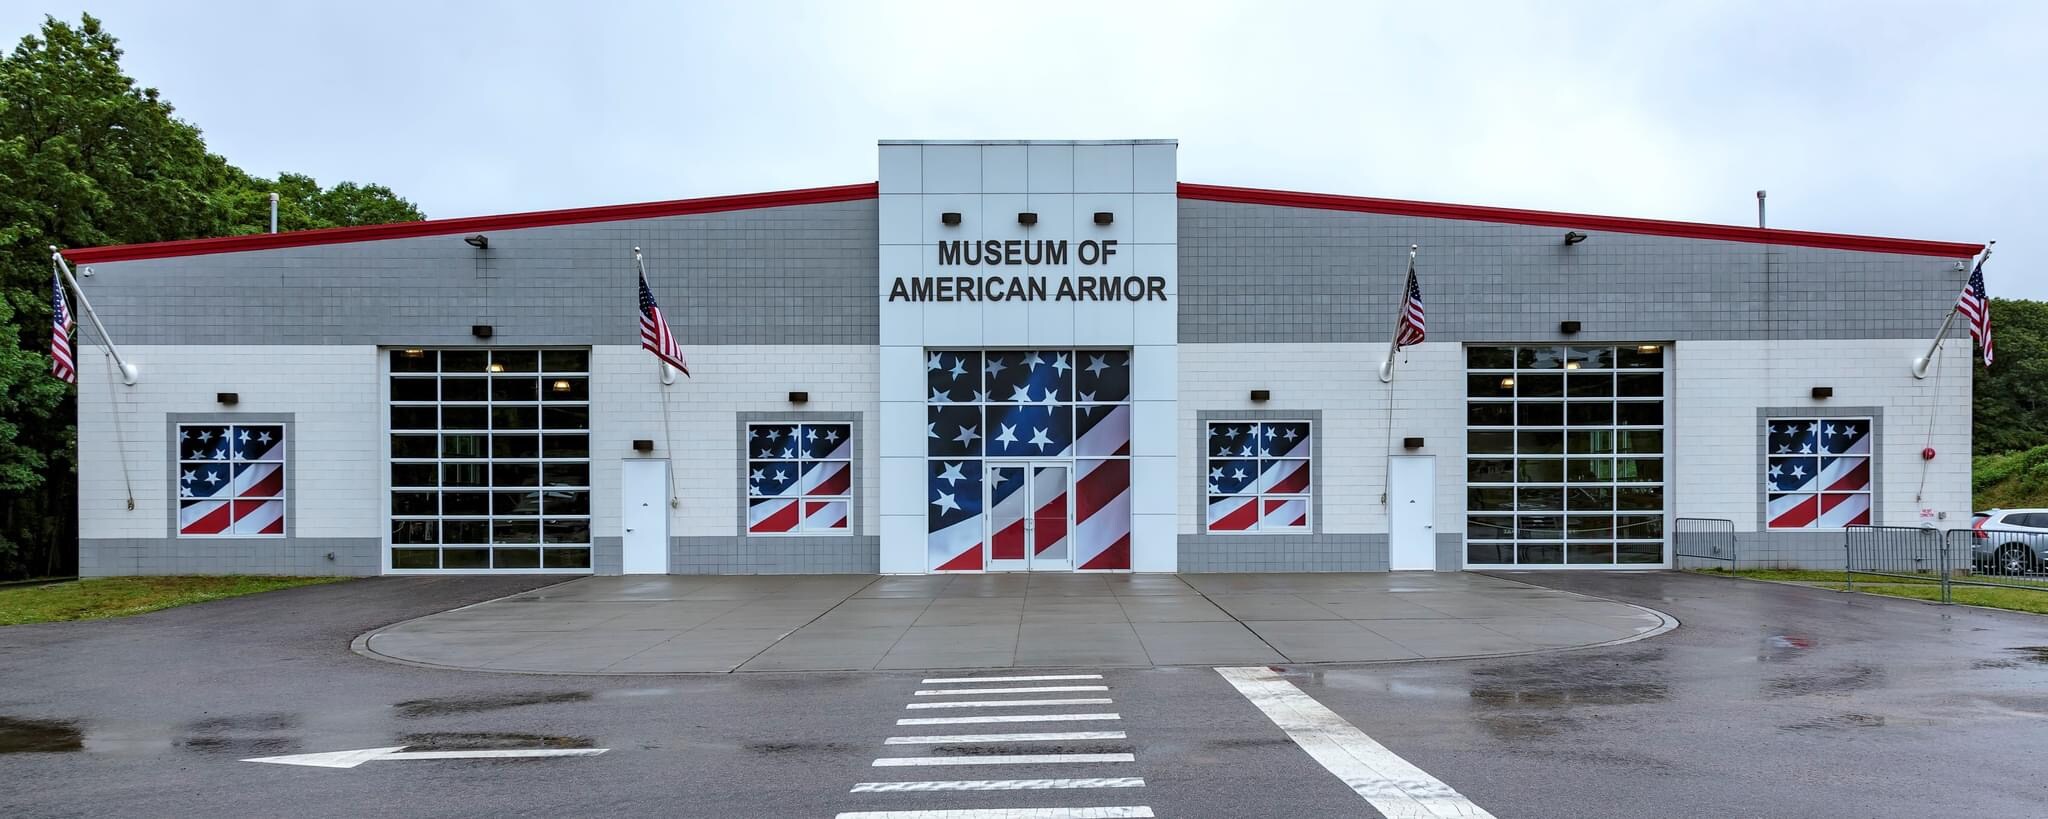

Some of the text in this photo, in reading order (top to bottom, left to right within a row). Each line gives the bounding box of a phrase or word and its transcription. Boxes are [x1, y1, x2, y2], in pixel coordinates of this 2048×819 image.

[938, 239, 1118, 266] MUSEUM OF
[888, 276, 1168, 302] AMERICAN ARMOR
